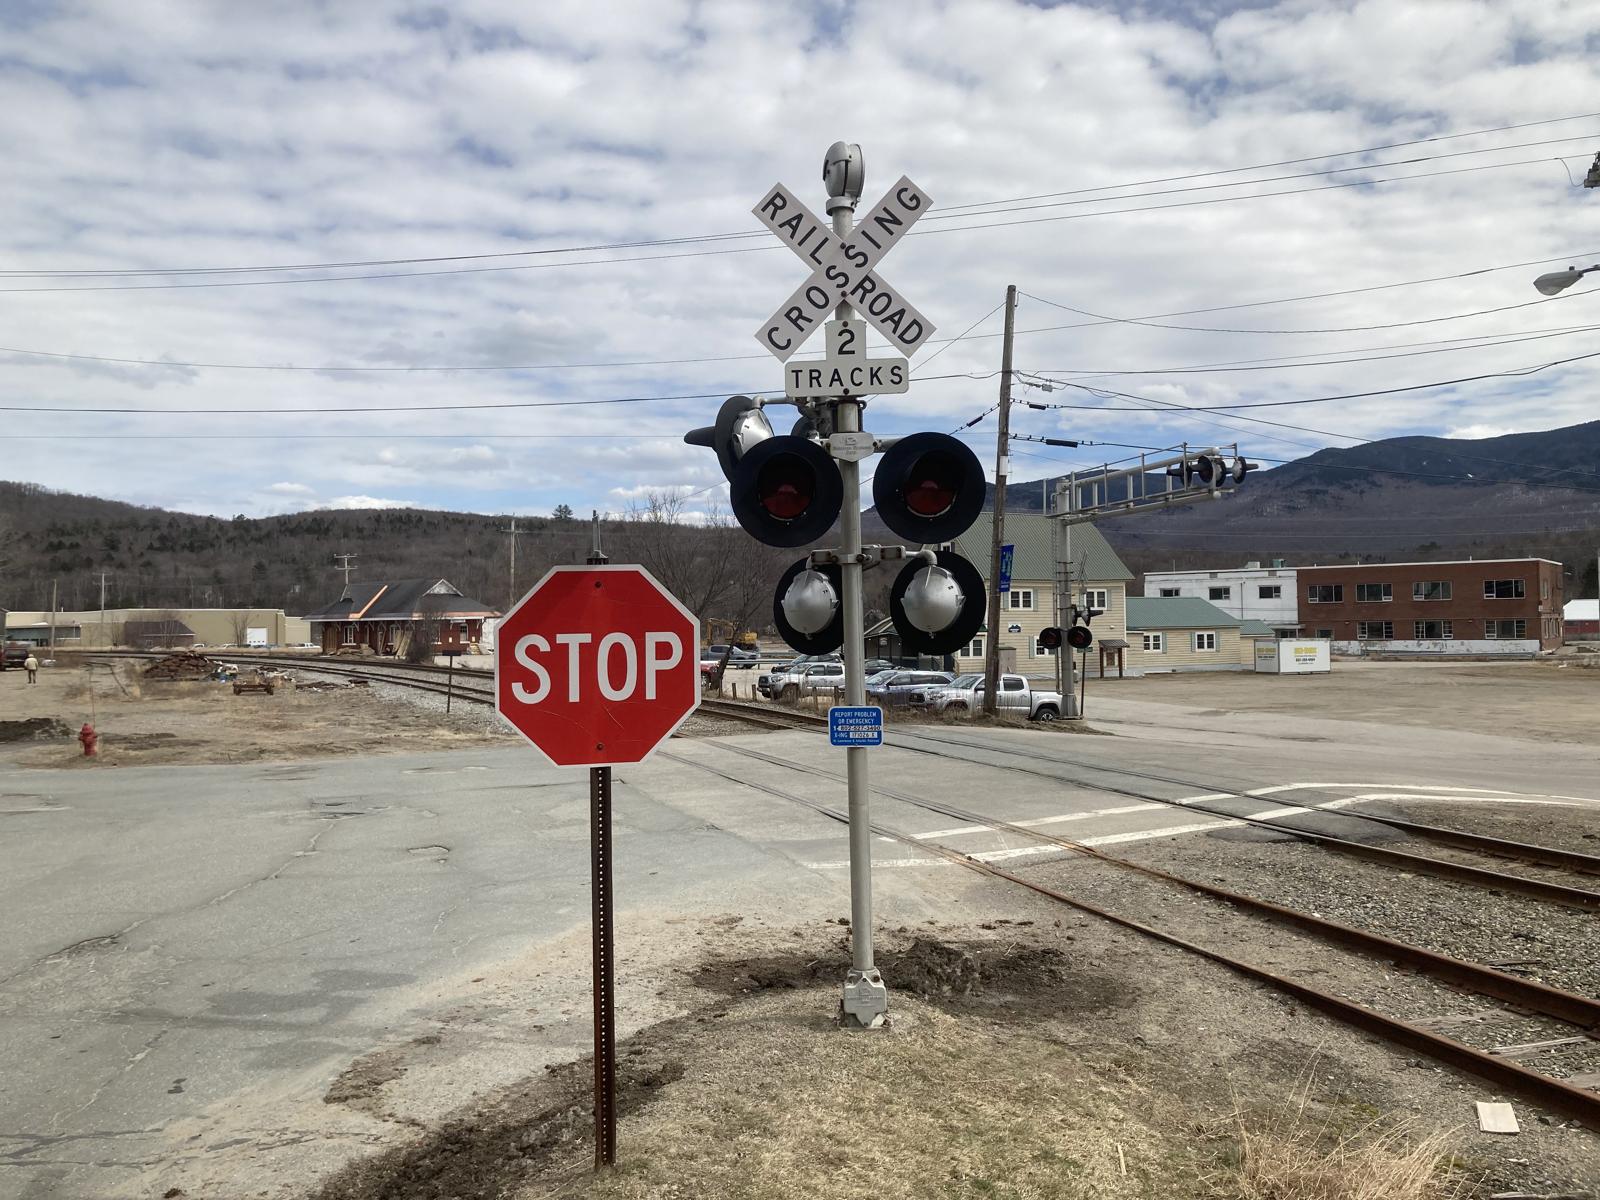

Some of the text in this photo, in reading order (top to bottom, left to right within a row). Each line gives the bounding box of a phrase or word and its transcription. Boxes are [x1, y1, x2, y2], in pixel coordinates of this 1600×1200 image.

[767, 187, 921, 351] CROSSING
[837, 328, 855, 355] 2
[791, 365, 903, 389] TRACKS
[511, 631, 683, 705] STOP
